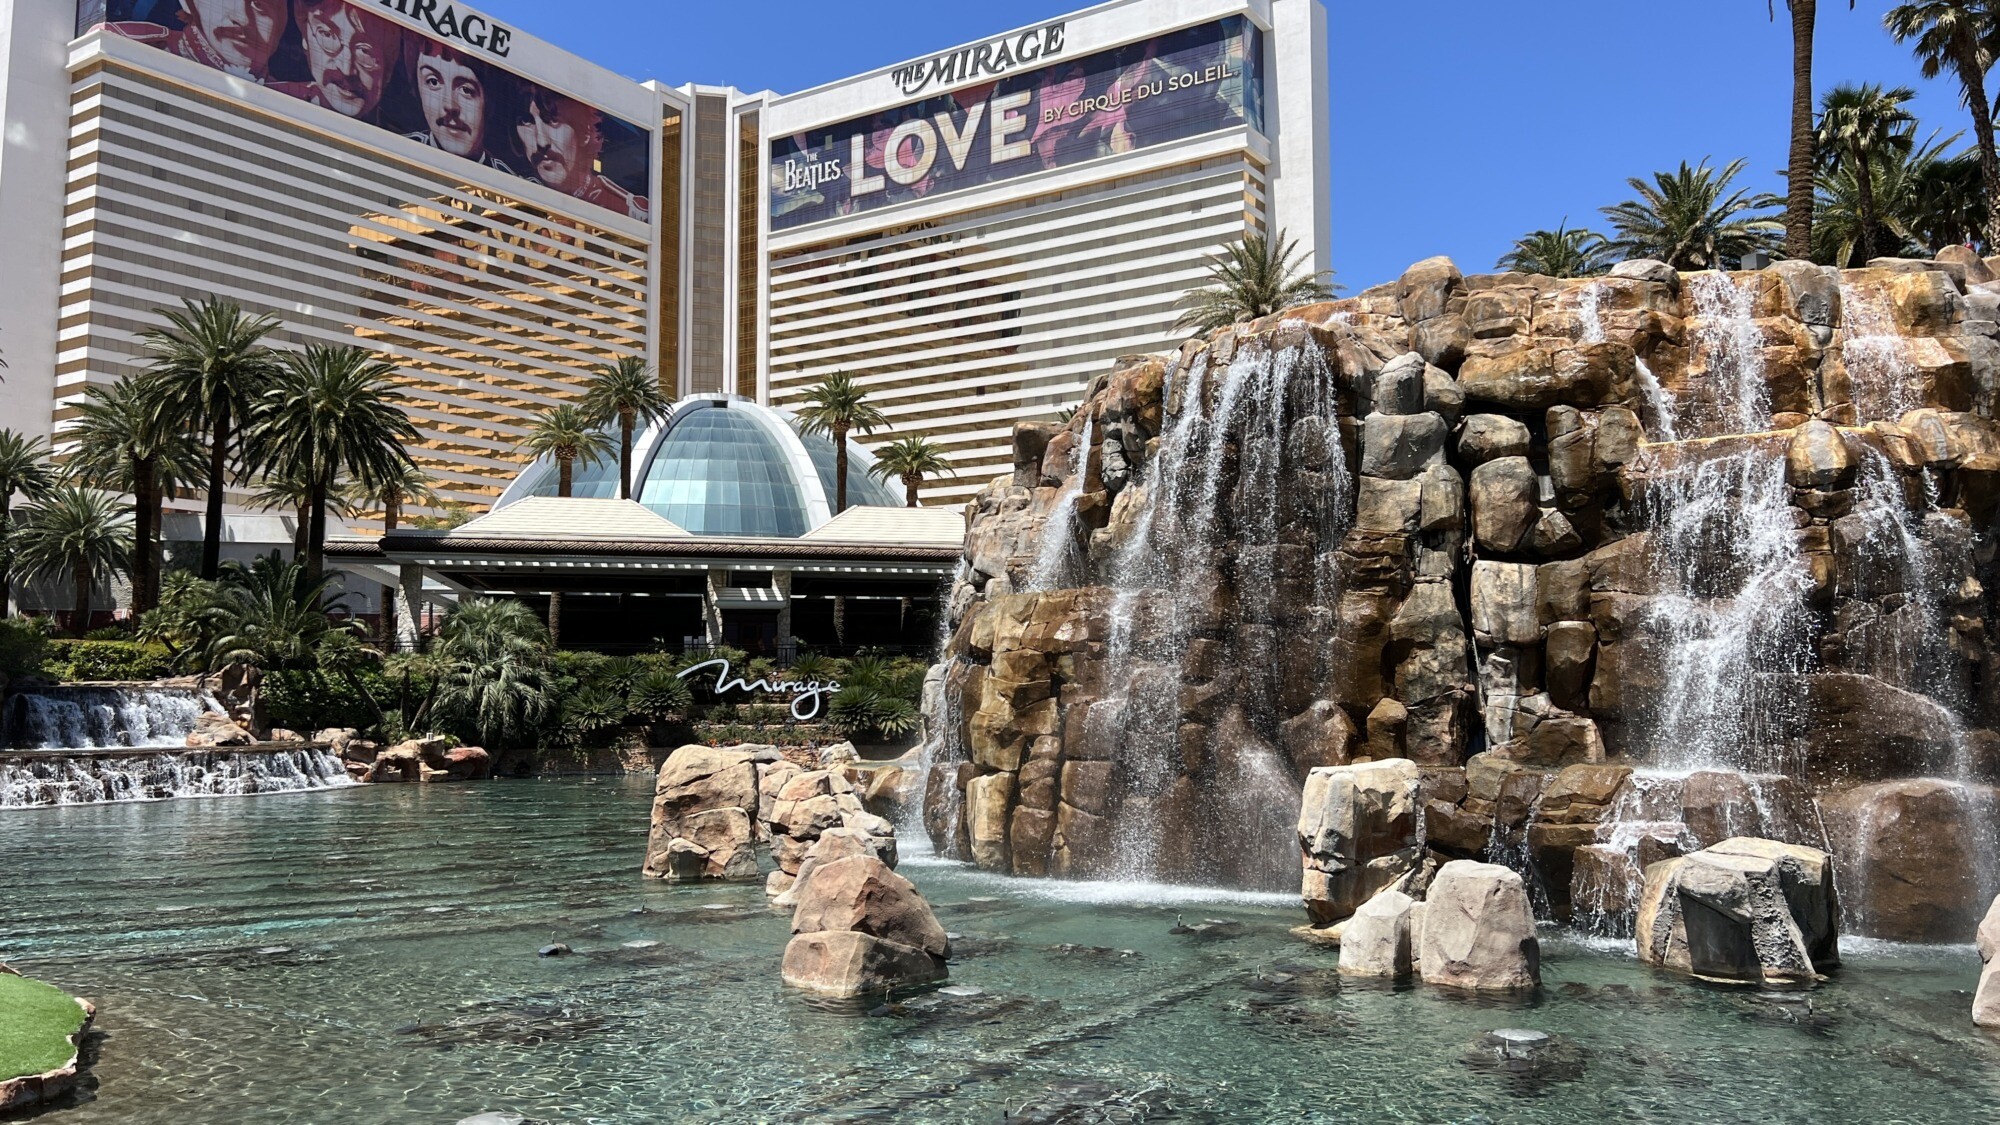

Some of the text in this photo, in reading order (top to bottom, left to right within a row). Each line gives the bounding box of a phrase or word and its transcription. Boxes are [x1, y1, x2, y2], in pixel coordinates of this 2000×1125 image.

[380, 0, 512, 58] RAGE
[891, 22, 1066, 94] THE MIRAGE
[1044, 63, 1233, 123] BY CIRQUE DU SOLEIL
[806, 152, 818, 163] THE
[850, 88, 1032, 198] LOVE
[675, 658, 842, 720] Mirage
